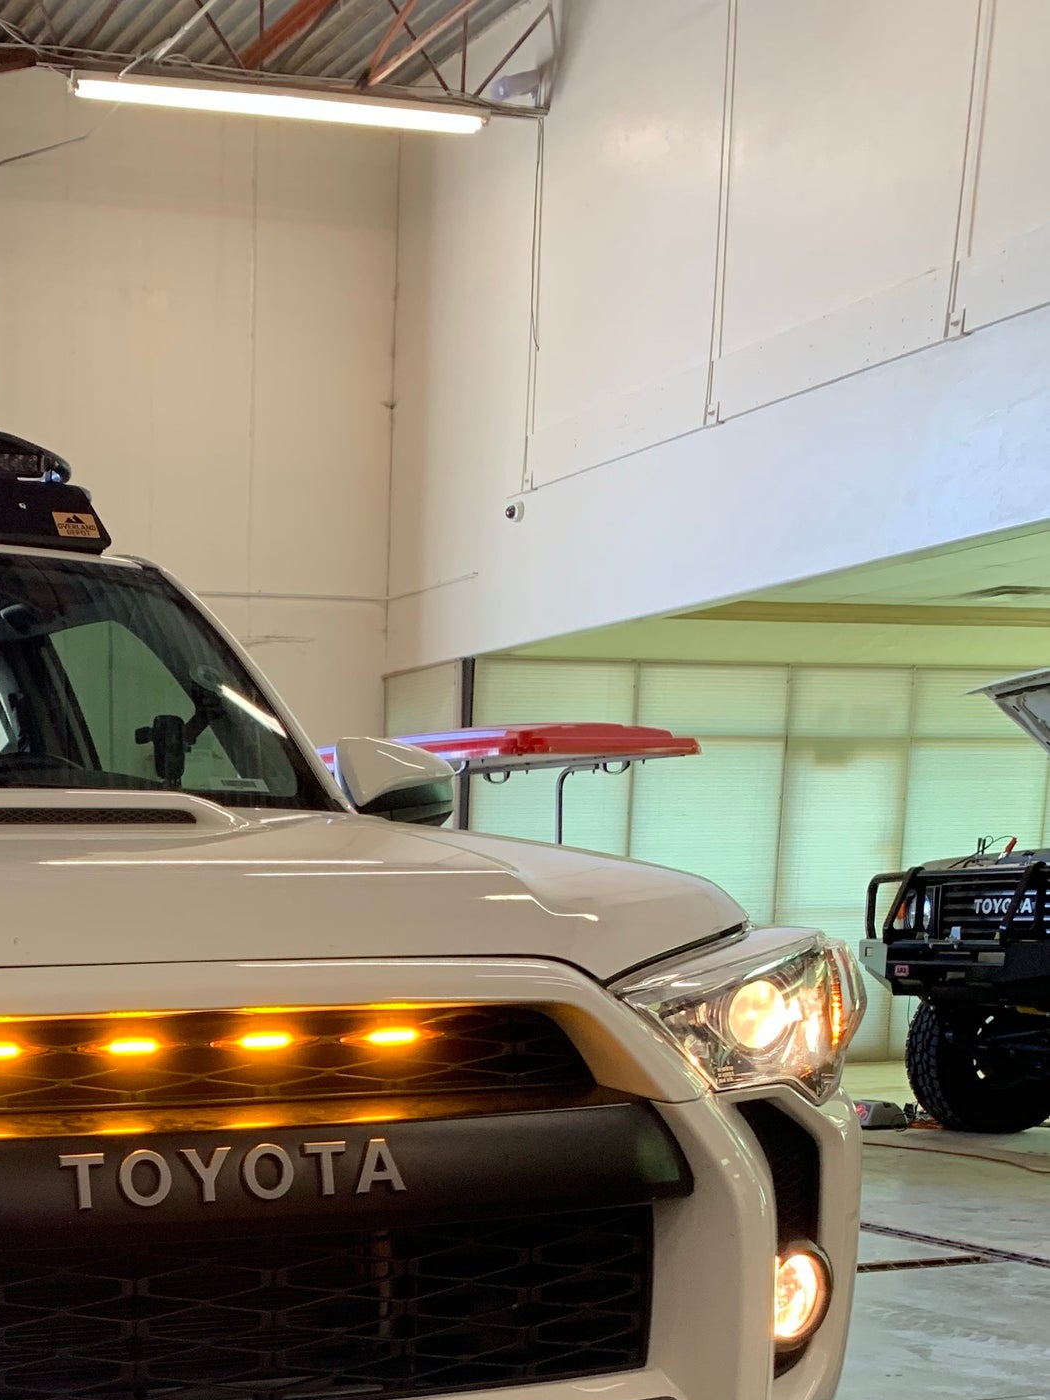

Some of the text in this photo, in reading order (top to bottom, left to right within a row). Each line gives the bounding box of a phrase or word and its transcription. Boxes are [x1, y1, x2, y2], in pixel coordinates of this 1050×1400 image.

[57, 522, 97, 531] OVERLAND
[974, 898, 1033, 914] TOYOA
[59, 1138, 406, 1210] TOYOTA
